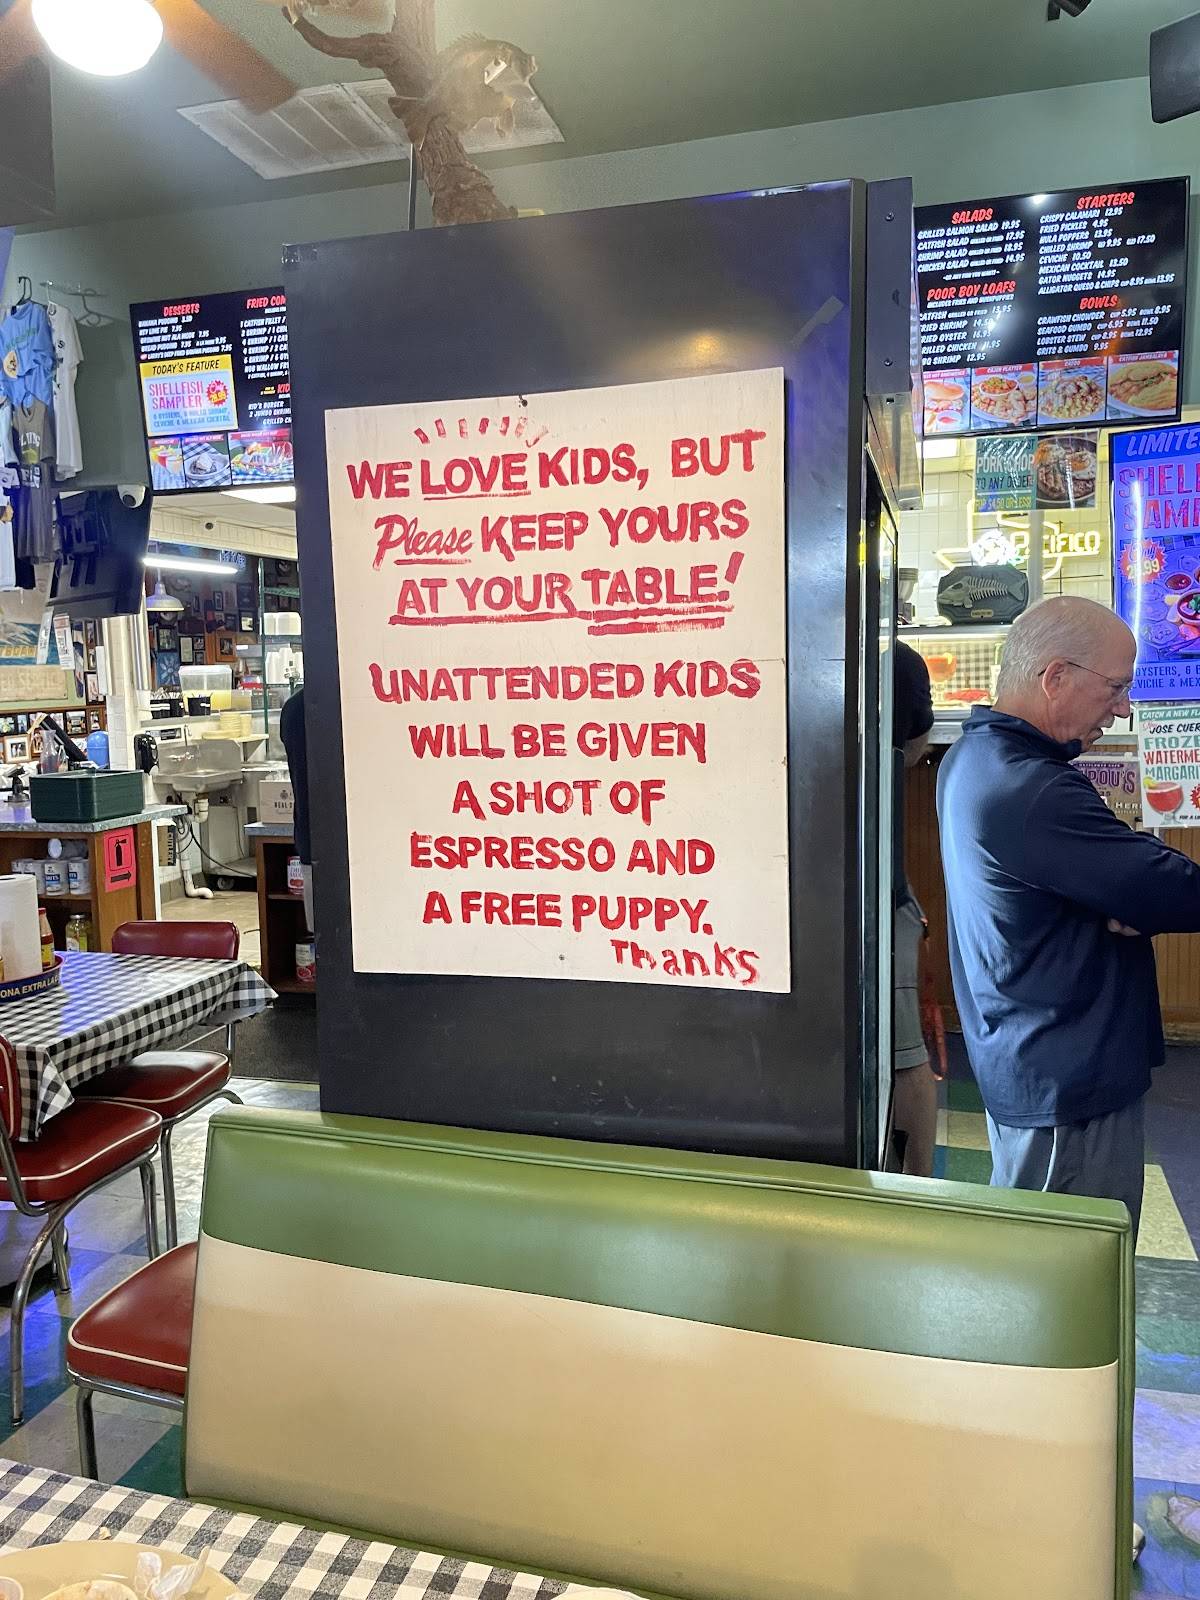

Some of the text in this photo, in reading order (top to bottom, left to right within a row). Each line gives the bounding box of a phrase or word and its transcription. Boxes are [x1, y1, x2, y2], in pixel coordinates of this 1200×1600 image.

[1076, 192, 1135, 209] STARTERS
[952, 208, 993, 224] SALADS
[1040, 207, 1123, 223] CRISPY CALAMARI 12.95
[917, 220, 1020, 239] GRILLED SALMON SALAD 19.95
[1040, 219, 1109, 234] FRIED PICKLES 4.95
[917, 240, 946, 250] CATFISH
[946, 237, 969, 247] SALAD
[1006, 230, 1025, 241] 17.95
[1040, 243, 1065, 254] CHILLED
[1066, 241, 1093, 252] SHRIMP
[1106, 238, 1122, 247] 9.95
[1137, 234, 1156, 244] 17.50
[1060, 231, 1089, 242] POPPERS
[917, 251, 944, 261] SHRIMP
[945, 248, 968, 259] SALAD
[1039, 251, 1092, 264] CEVICHE 10.50
[918, 262, 946, 273] CHICKEN
[946, 259, 969, 270] SALAD
[1005, 253, 1025, 263] 14.95
[1038, 264, 1070, 275] MEXICAN
[1071, 260, 1104, 271] COCKTAIL
[1038, 274, 1061, 285] GATOR
[1098, 269, 1116, 279] 14.95
[927, 281, 1016, 301] POOR BOY LOAFS
[1038, 284, 1072, 295] ALLIGATOR
[1073, 282, 1094, 292] QUESO
[1100, 279, 1120, 289] CHIPS
[164, 303, 200, 316] DESSERTS
[247, 297, 269, 309] FRIED
[1080, 294, 1119, 310] BOWLS
[1038, 314, 1071, 325] CRAWFISH
[1072, 311, 1106, 322] CHOWDER
[1121, 308, 1138, 318] 5.95
[1154, 305, 1172, 314] 8.95
[920, 323, 938, 332] RIED
[939, 320, 968, 331] SHRIMP
[1038, 325, 1067, 335] SEAFOOD
[1068, 323, 1092, 332] GUMBO
[1108, 320, 1124, 328] 6.95
[921, 335, 938, 343] RIED
[939, 332, 967, 342] OYSTER
[1037, 335, 1066, 346] LOBSTER
[1067, 334, 1086, 343] STEW
[1135, 328, 1153, 337] 12.95
[921, 344, 945, 354] RILLED
[947, 342, 977, 352] CHICKEN
[1037, 342, 1109, 356] GRITS & GUMBO 9.95
[933, 353, 986, 365] SHRIMP 12.95
[153, 360, 219, 375] TODAY'S FEATURE
[149, 380, 204, 396] SHELLFISH
[153, 395, 202, 409] SAMPLER
[1127, 429, 1200, 456] LIMITE
[347, 429, 766, 499] WE LOVE KIDS, BUT
[977, 456, 1004, 473] PORK
[989, 478, 1004, 489] ANY
[372, 498, 749, 571] Please KEEP YOURS
[1010, 531, 1100, 555] PCIFICO
[397, 551, 745, 617] AT YOUR TABLE!
[1185, 666, 1191, 674] 6
[369, 659, 761, 704] UNATTENDED KIDS
[1169, 678, 1175, 687] &
[1142, 711, 1165, 719] CATCH
[1172, 709, 1189, 718] NEW
[1150, 724, 1173, 734] JOSE
[408, 722, 707, 763] WILL BE GIVEN
[1086, 769, 1136, 794] POU'S
[452, 779, 666, 826] A SHOT OF
[410, 832, 716, 875] ESPRESSO AND
[422, 890, 713, 935] A FREE PUPPY.
[610, 939, 761, 985] Thanks
[22, 980, 47, 994] EXTRA
